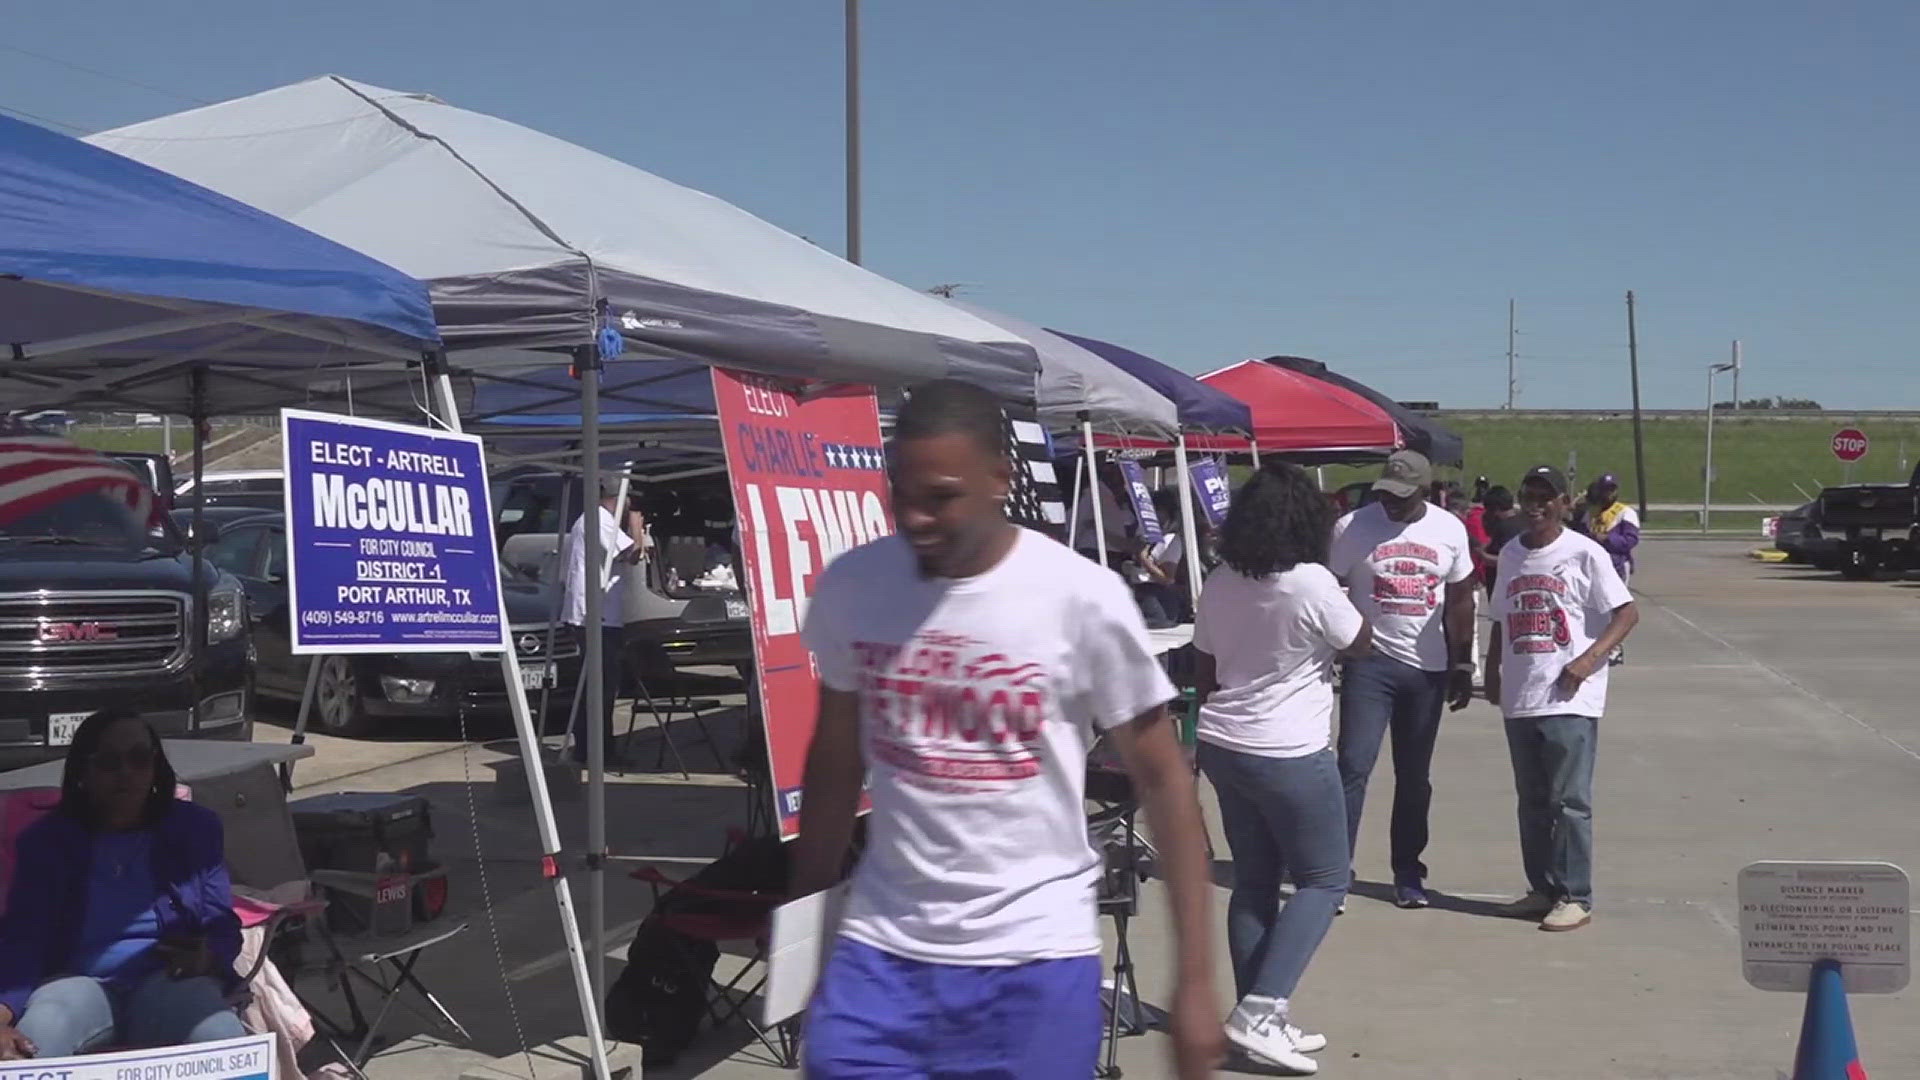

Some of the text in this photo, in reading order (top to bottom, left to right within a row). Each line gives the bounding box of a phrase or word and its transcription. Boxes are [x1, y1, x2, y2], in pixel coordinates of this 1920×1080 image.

[740, 373, 789, 418] ELECT
[738, 422, 825, 478] CHARLIE
[1834, 437, 1866, 452] STOP
[310, 441, 373, 467] ELECT
[387, 450, 465, 478] ARTRELL
[360, 538, 438, 558] FOR CITY COUNCIL
[356, 560, 426, 579] DISTRICT
[338, 586, 472, 608] PORT ARTHUR, TX
[301, 610, 385, 628] (409) 549-8716
[1551, 608, 1571, 646] 3
[40, 622, 117, 640] GMC
[53, 725, 75, 738] NZJ
[377, 885, 406, 903] LEWIS
[1780, 886, 1865, 895] DISTANCE MARKER
[1743, 904, 1757, 912] NO
[1760, 904, 1836, 914] ELECTIONEERING
[1855, 906, 1905, 915] LOITERING
[1755, 923, 1796, 932] BETWEEN
[1822, 925, 1850, 933] POINT
[1854, 925, 1874, 934] AND
[1877, 926, 1894, 935] THE
[1748, 941, 1794, 950] ENTRANCE
[1797, 942, 1808, 950] TO
[1831, 943, 1871, 952] POLLING
[1873, 943, 1902, 953] PLACE
[117, 1051, 258, 1080] FOR CITY COUNCIL SEAT
